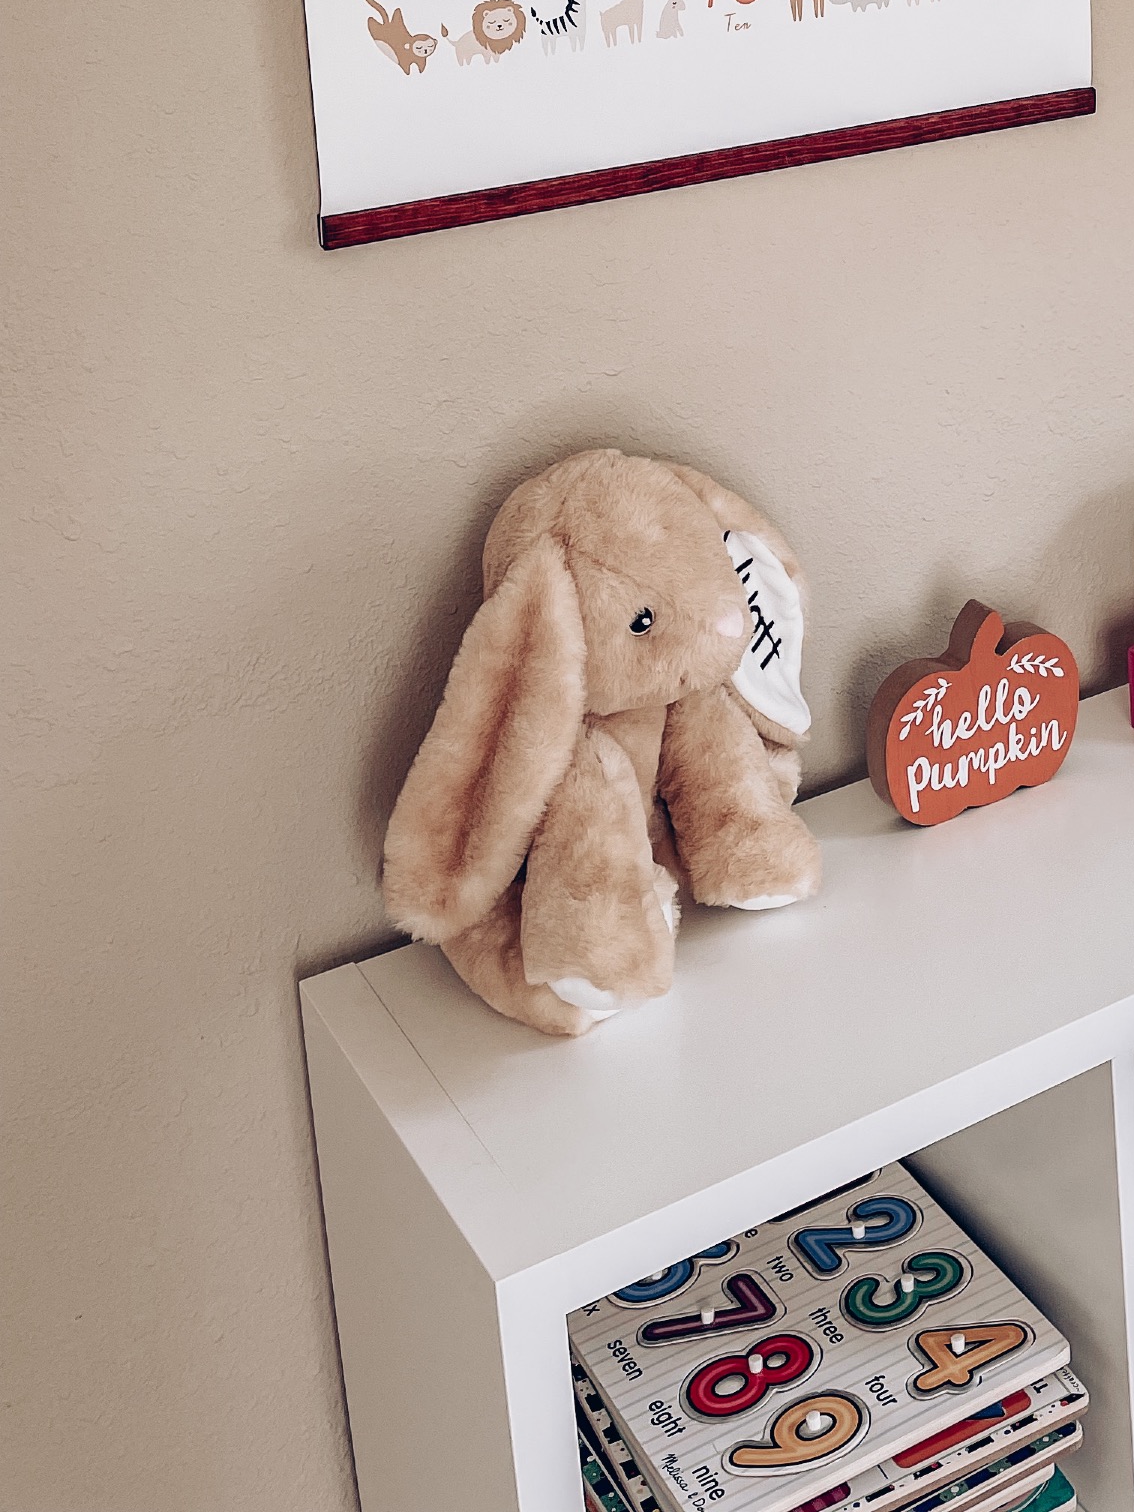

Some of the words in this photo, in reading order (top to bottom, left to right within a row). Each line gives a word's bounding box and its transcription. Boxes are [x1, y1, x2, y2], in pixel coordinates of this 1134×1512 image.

[723, 13, 752, 33] Ten
[925, 678, 1040, 750] hello
[794, 1197, 916, 1272] 2
[766, 1255, 794, 1282] two
[844, 1251, 963, 1325] 3
[641, 1273, 777, 1341] 7
[808, 1307, 844, 1345] three
[607, 1339, 643, 1381] seven
[686, 1334, 814, 1418] 8
[914, 1322, 1028, 1391] 4
[865, 1375, 897, 1406] four
[648, 1399, 686, 1438] eight
[728, 1393, 862, 1469] 9
[661, 1453, 689, 1492] Melissa
[692, 1465, 725, 1501] nine
